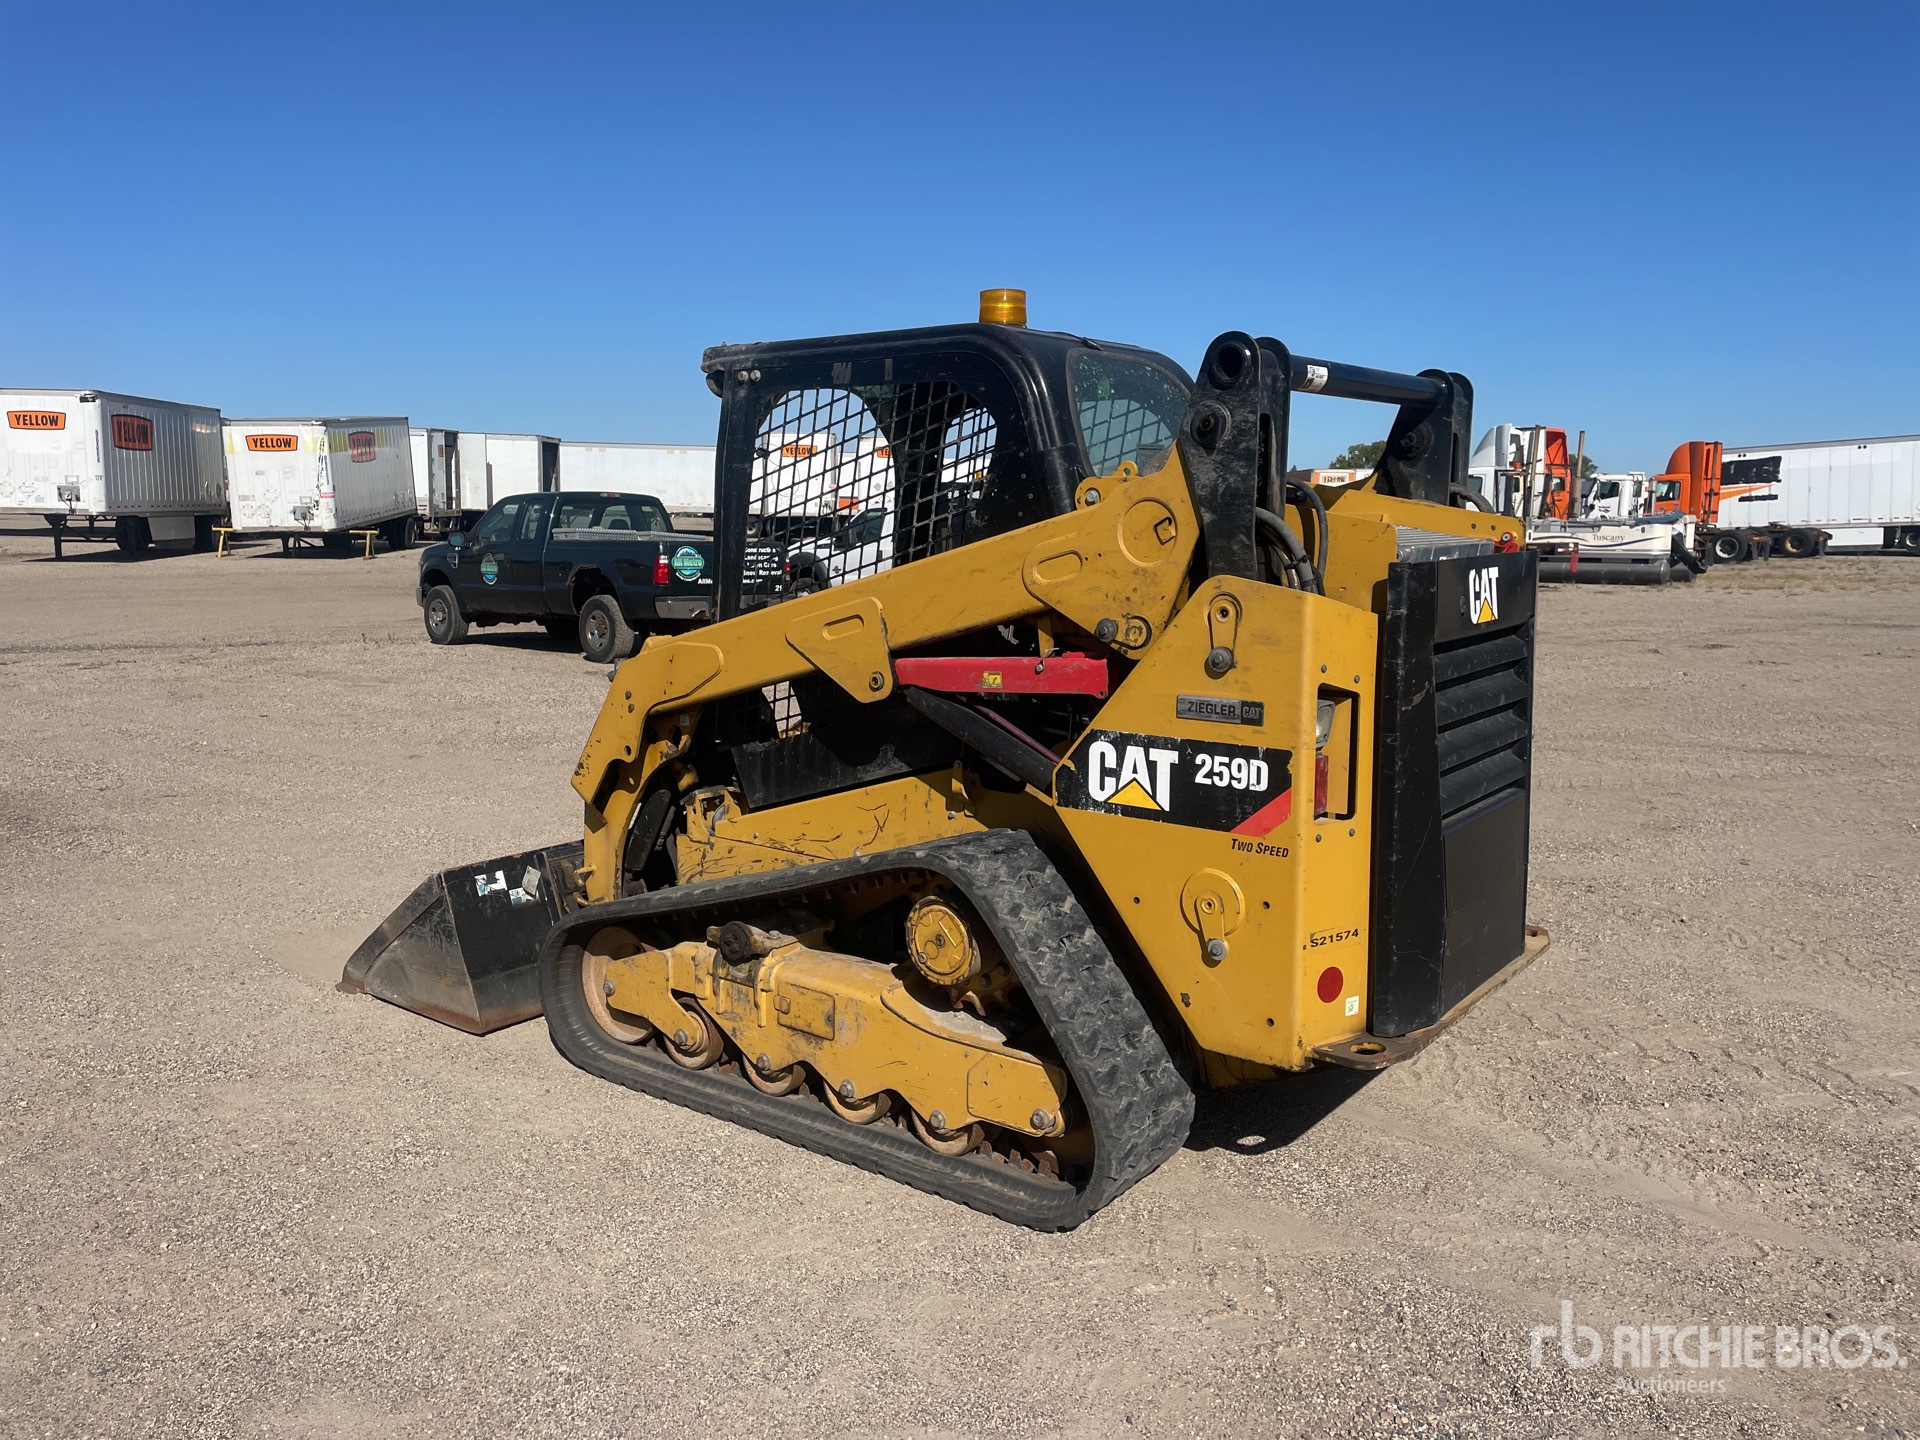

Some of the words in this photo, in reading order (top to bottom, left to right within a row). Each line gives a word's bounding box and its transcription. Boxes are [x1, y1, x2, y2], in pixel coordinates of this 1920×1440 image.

[14, 414, 59, 427] YELLOW
[116, 420, 149, 445] YELLOW
[252, 437, 292, 448] YELLOW
[785, 446, 812, 456] YELOW
[1592, 533, 1626, 541] Tuscany
[1468, 566, 1499, 625] CAT
[1187, 701, 1236, 717] ZIEGLER
[1242, 705, 1262, 720] CAT
[1088, 740, 1179, 812] CAT
[1194, 753, 1269, 792] 259D
[1310, 928, 1359, 948] S21574
